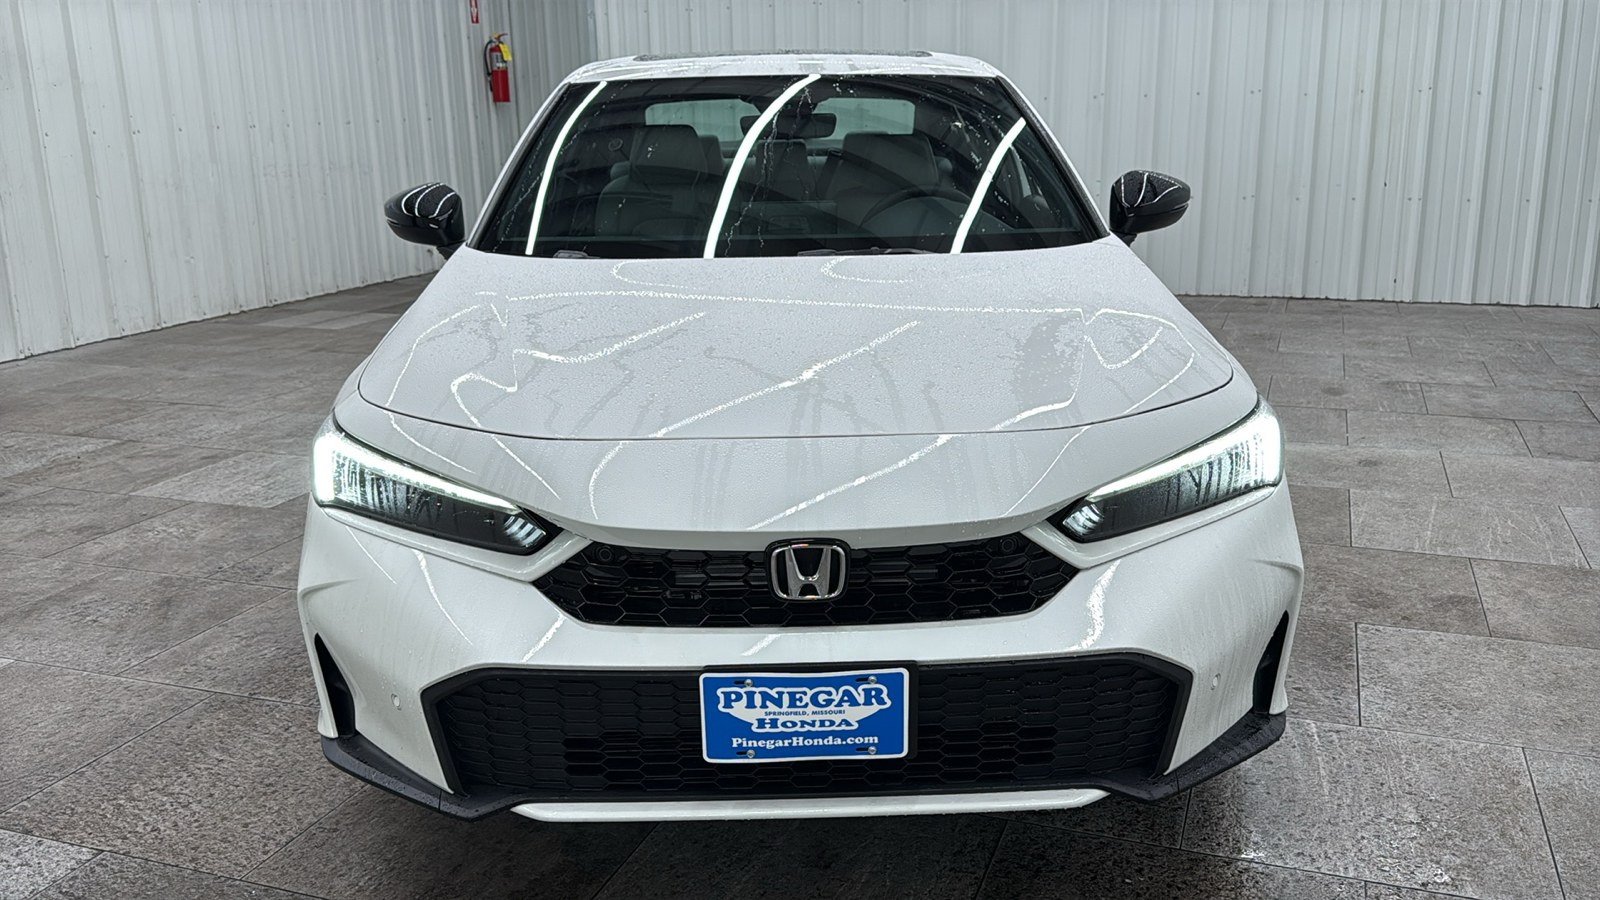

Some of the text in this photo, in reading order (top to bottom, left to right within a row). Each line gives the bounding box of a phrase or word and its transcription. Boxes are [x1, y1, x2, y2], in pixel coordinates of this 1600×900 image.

[720, 686, 888, 709] PINEGAR
[755, 718, 854, 730] HONDA
[731, 735, 879, 749] PinegarHonda.com
